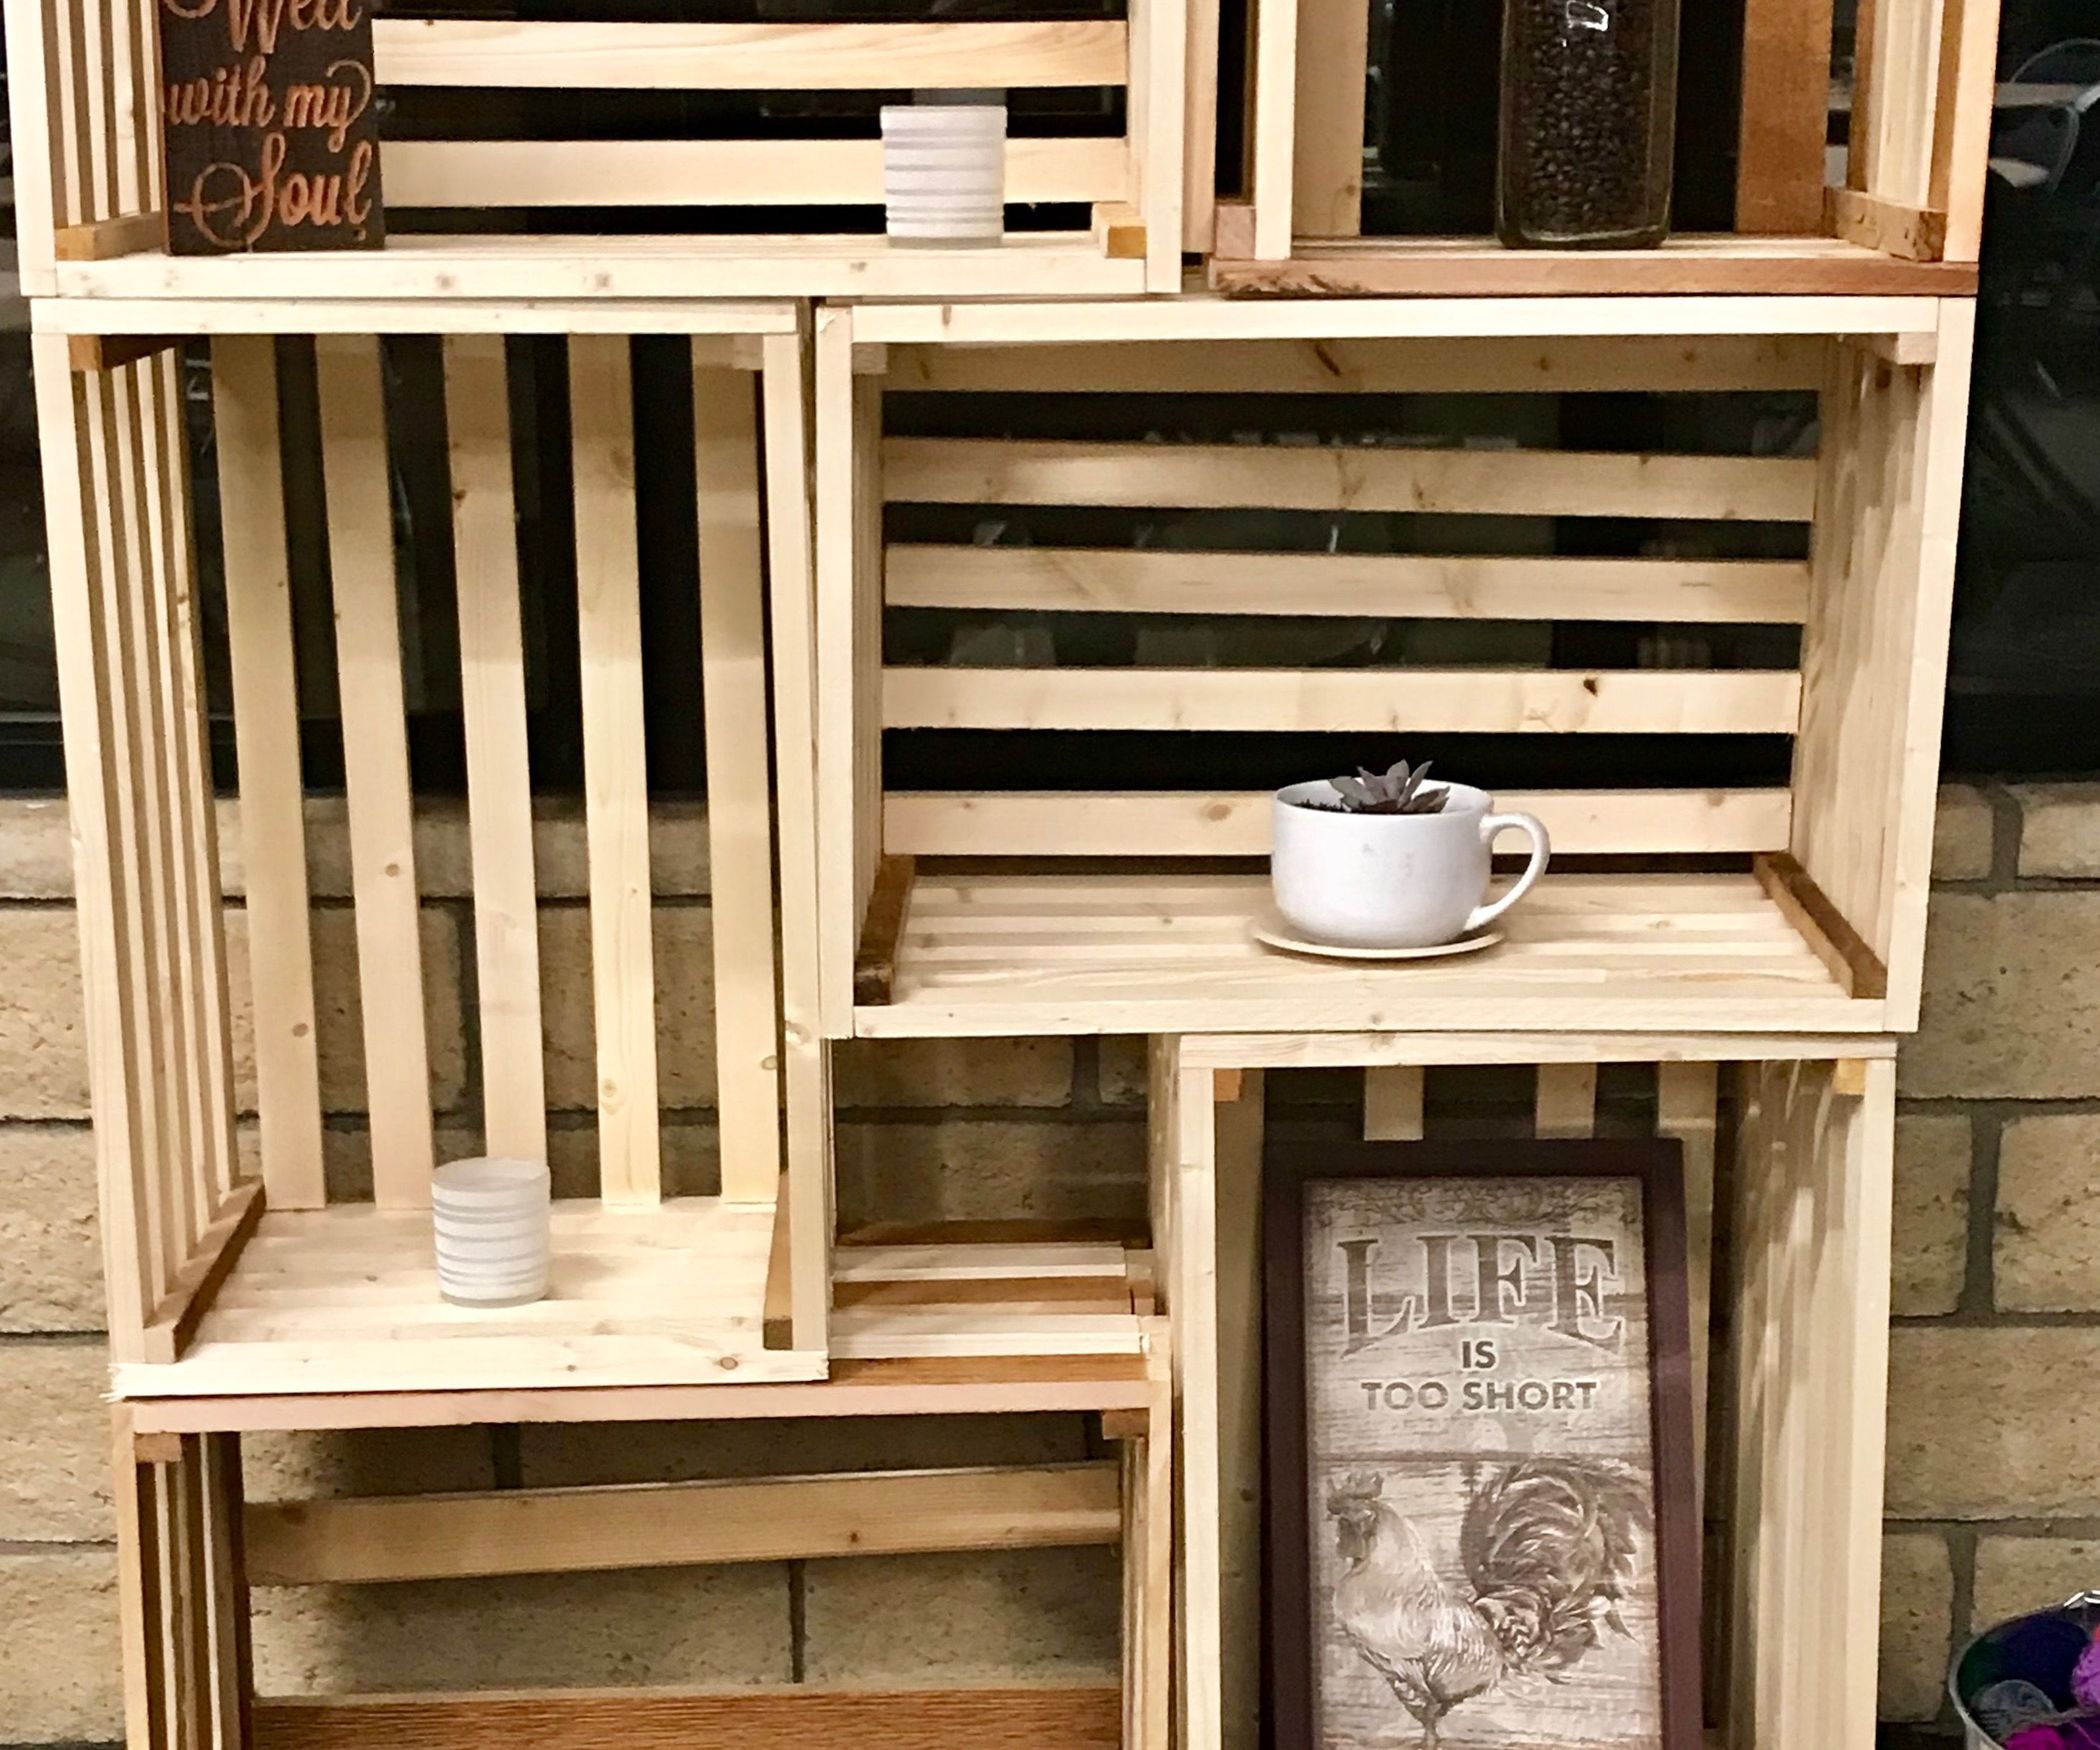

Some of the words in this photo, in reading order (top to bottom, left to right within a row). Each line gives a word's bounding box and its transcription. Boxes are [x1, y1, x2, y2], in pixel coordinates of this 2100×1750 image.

[169, 55, 275, 127] with
[283, 59, 371, 153] my
[173, 132, 372, 245] Soul
[1337, 1234, 1624, 1359] LIFE
[1361, 1381, 1449, 1410] TOO
[1462, 1381, 1597, 1410] SHORT
[1462, 1341, 1496, 1369] IS
